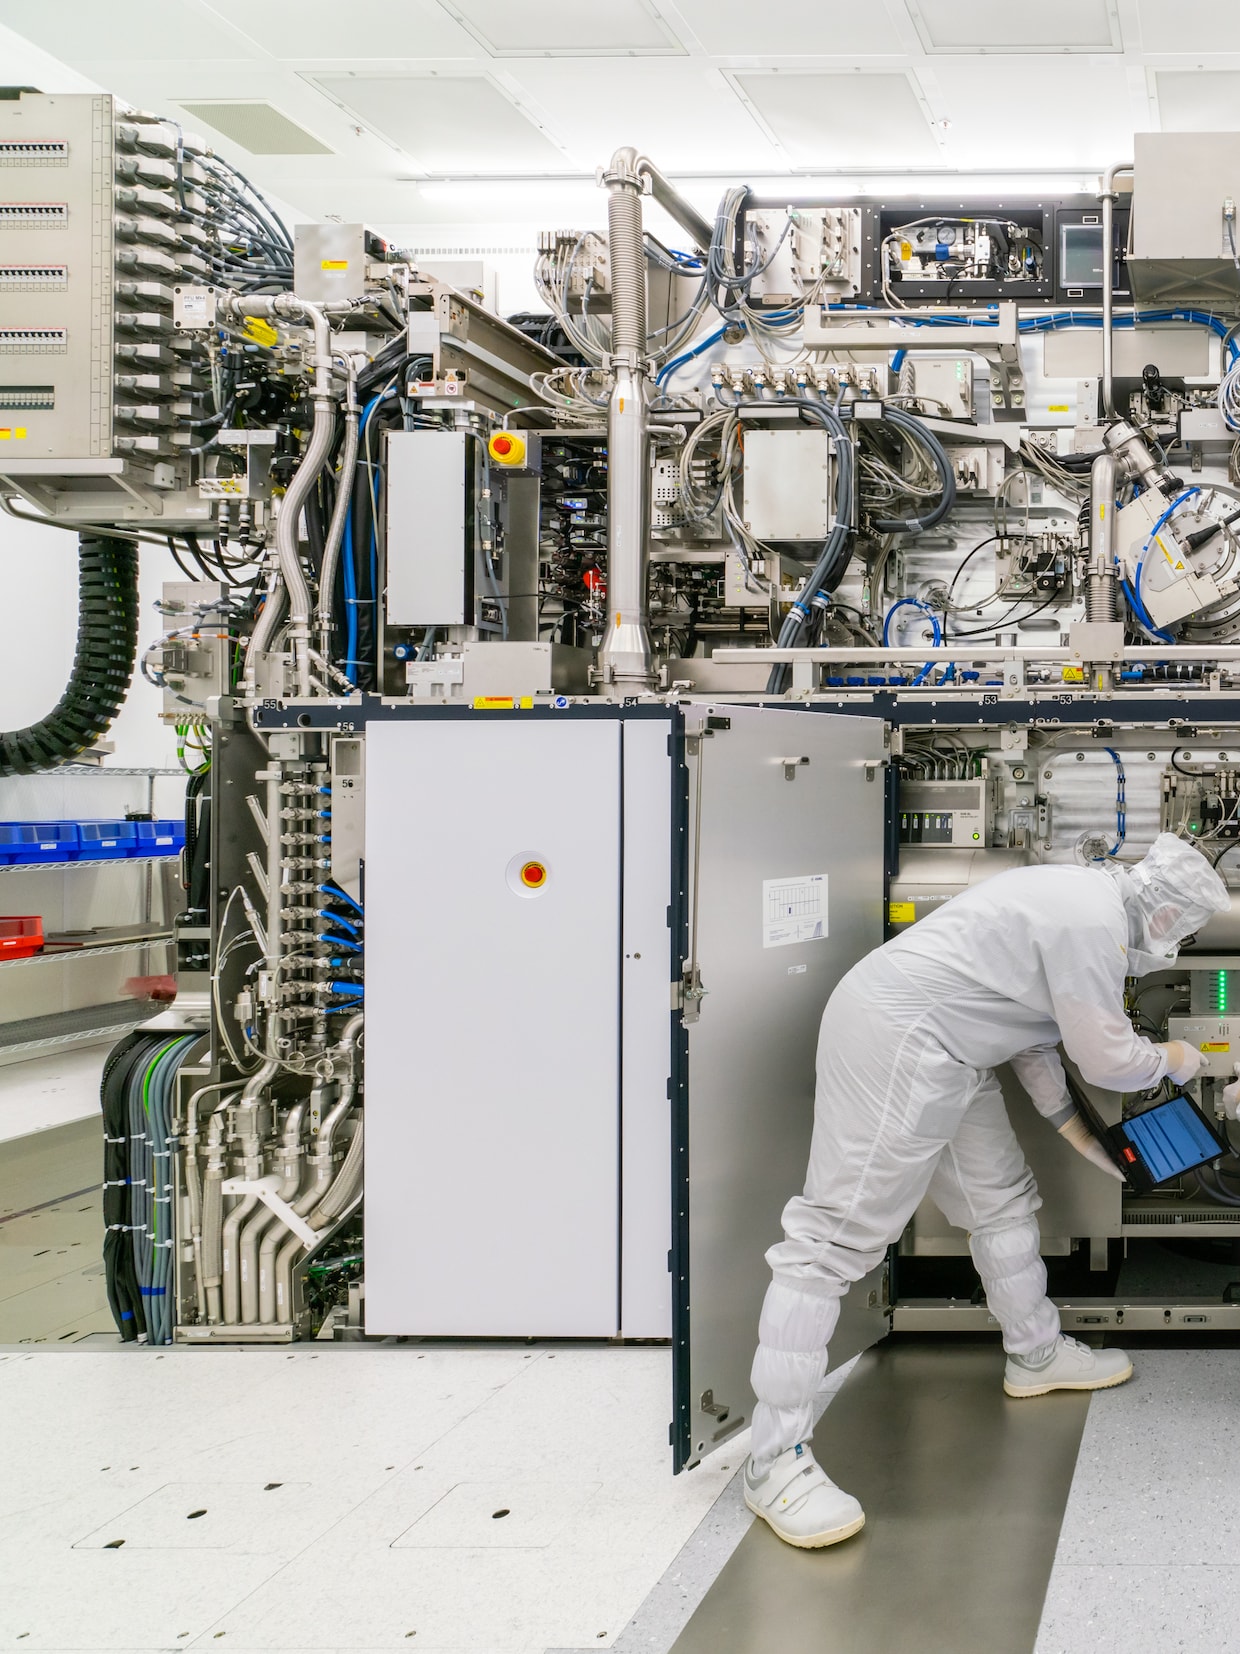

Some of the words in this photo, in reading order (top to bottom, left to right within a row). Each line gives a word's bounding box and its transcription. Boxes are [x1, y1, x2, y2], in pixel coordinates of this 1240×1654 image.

[263, 700, 277, 709] 55
[625, 697, 637, 708] 54
[984, 695, 997, 705] 53
[1060, 695, 1073, 705] 53
[342, 722, 355, 731] 56
[342, 779, 354, 788] 56
